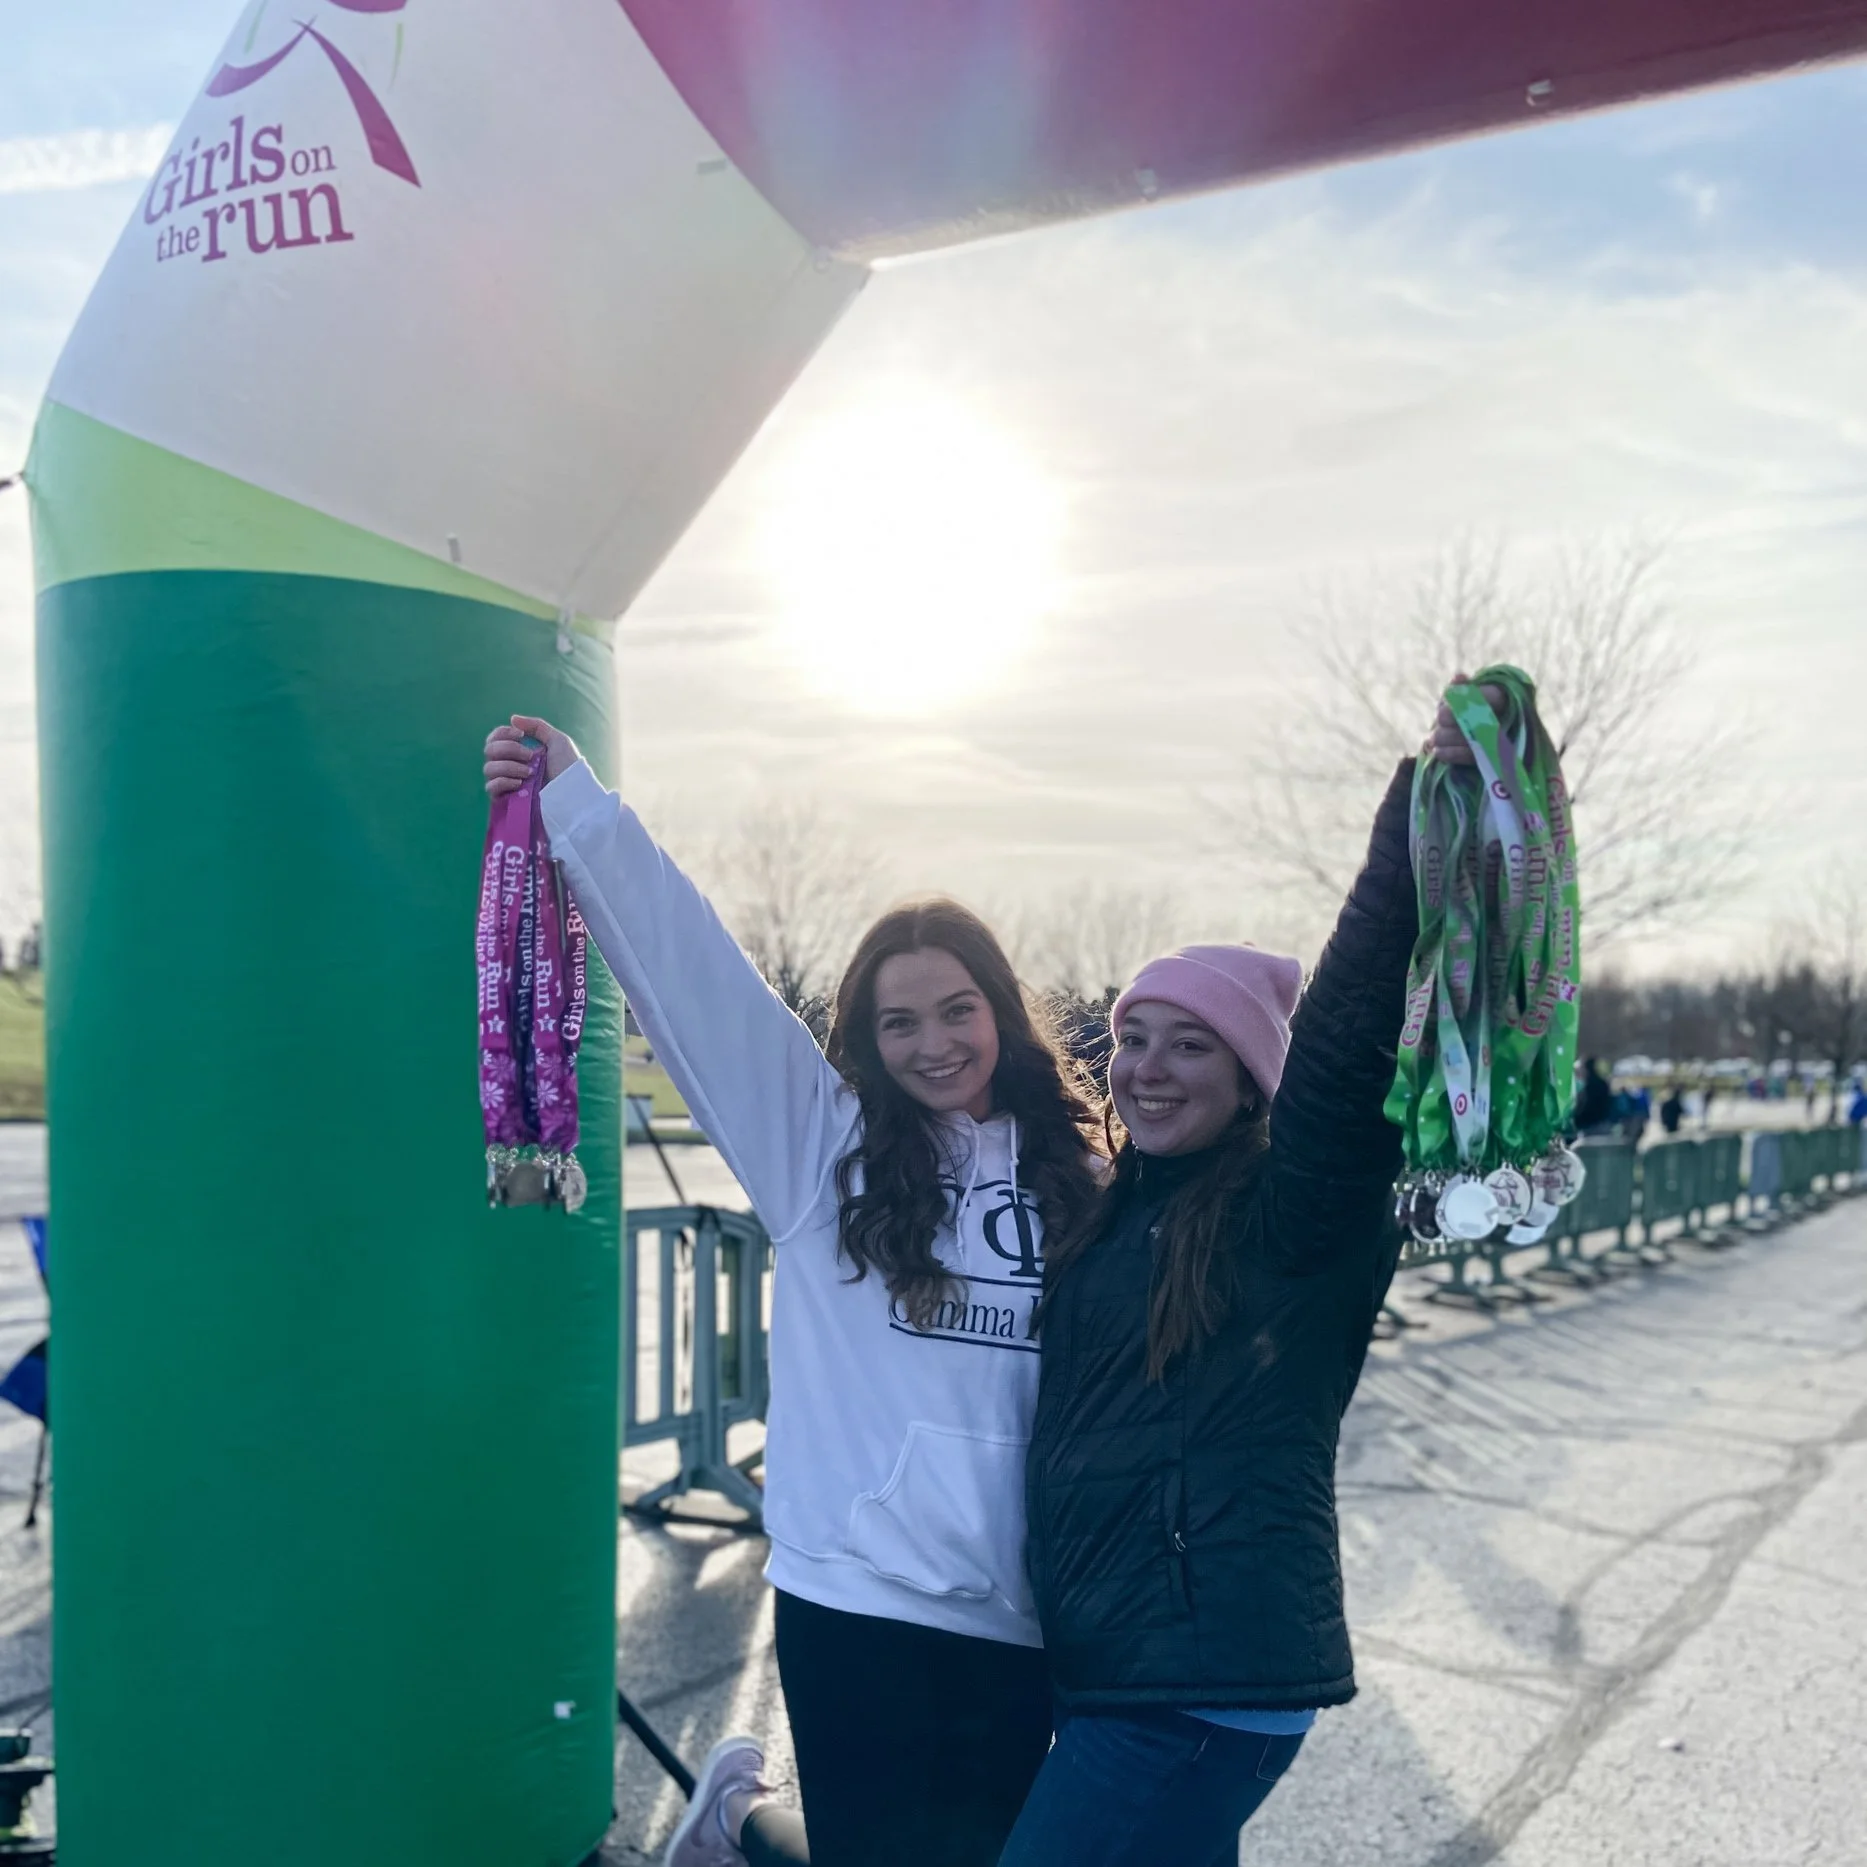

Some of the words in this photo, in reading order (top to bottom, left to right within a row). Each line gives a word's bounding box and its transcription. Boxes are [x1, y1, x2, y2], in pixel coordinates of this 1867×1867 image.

[144, 115, 286, 225] Girls
[290, 145, 338, 177] on
[156, 225, 200, 262] the
[202, 182, 355, 262] run
[502, 846, 525, 906] Girls
[571, 937, 585, 963] the
[574, 965, 585, 986] on
[487, 960, 502, 1011] Run
[535, 959, 553, 1010] Run
[561, 988, 585, 1041] Girls
[888, 1296, 1017, 1339] Gmma
